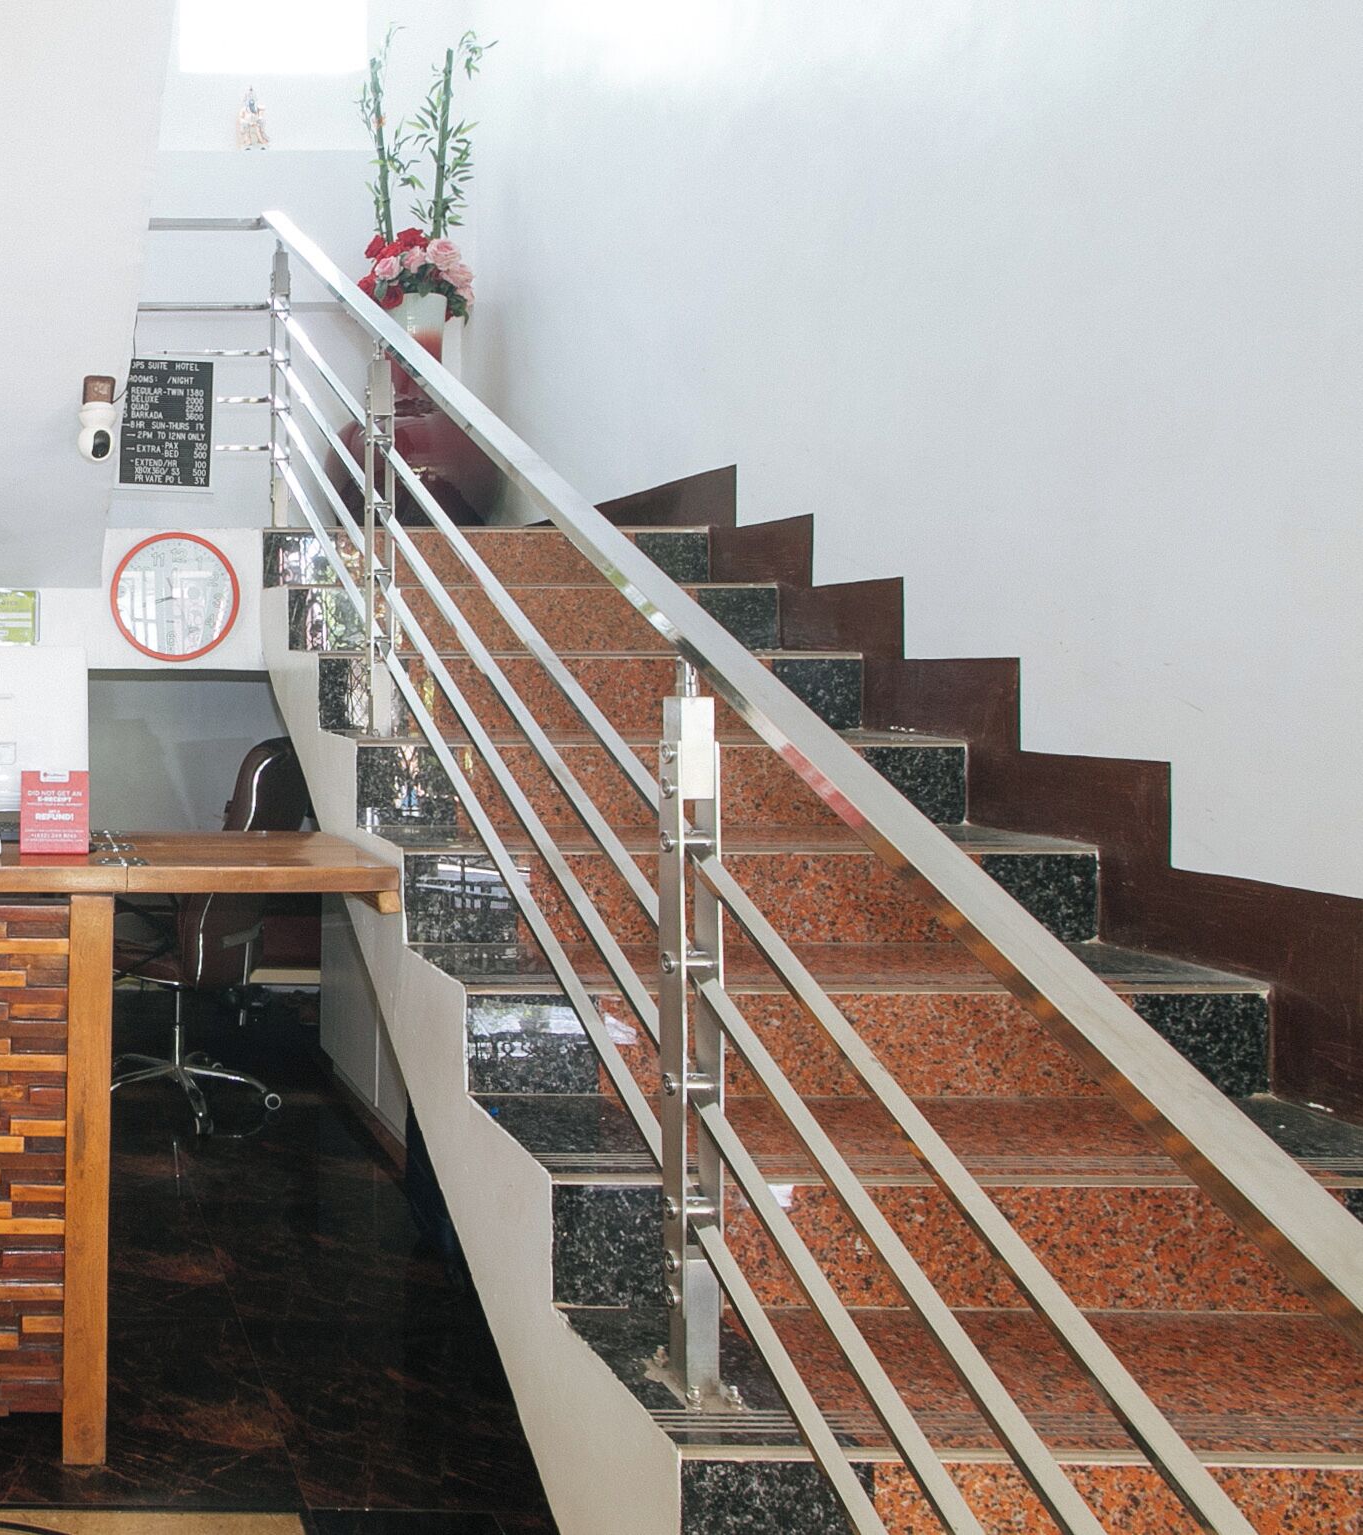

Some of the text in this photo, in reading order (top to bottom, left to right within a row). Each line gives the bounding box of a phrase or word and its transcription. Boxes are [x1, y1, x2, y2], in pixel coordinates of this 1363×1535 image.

[148, 362, 168, 370] SUITE
[175, 362, 200, 371] HOTEL
[131, 395, 159, 403] DELUXE
[130, 403, 149, 411] QUAD
[130, 410, 163, 419] BARKADA
[187, 433, 205, 441] ONLY
[194, 442, 208, 451] 350
[193, 451, 207, 459] 500
[194, 460, 207, 469] 100
[192, 468, 206, 477] 500
[35, 813, 74, 821] REFUND!
